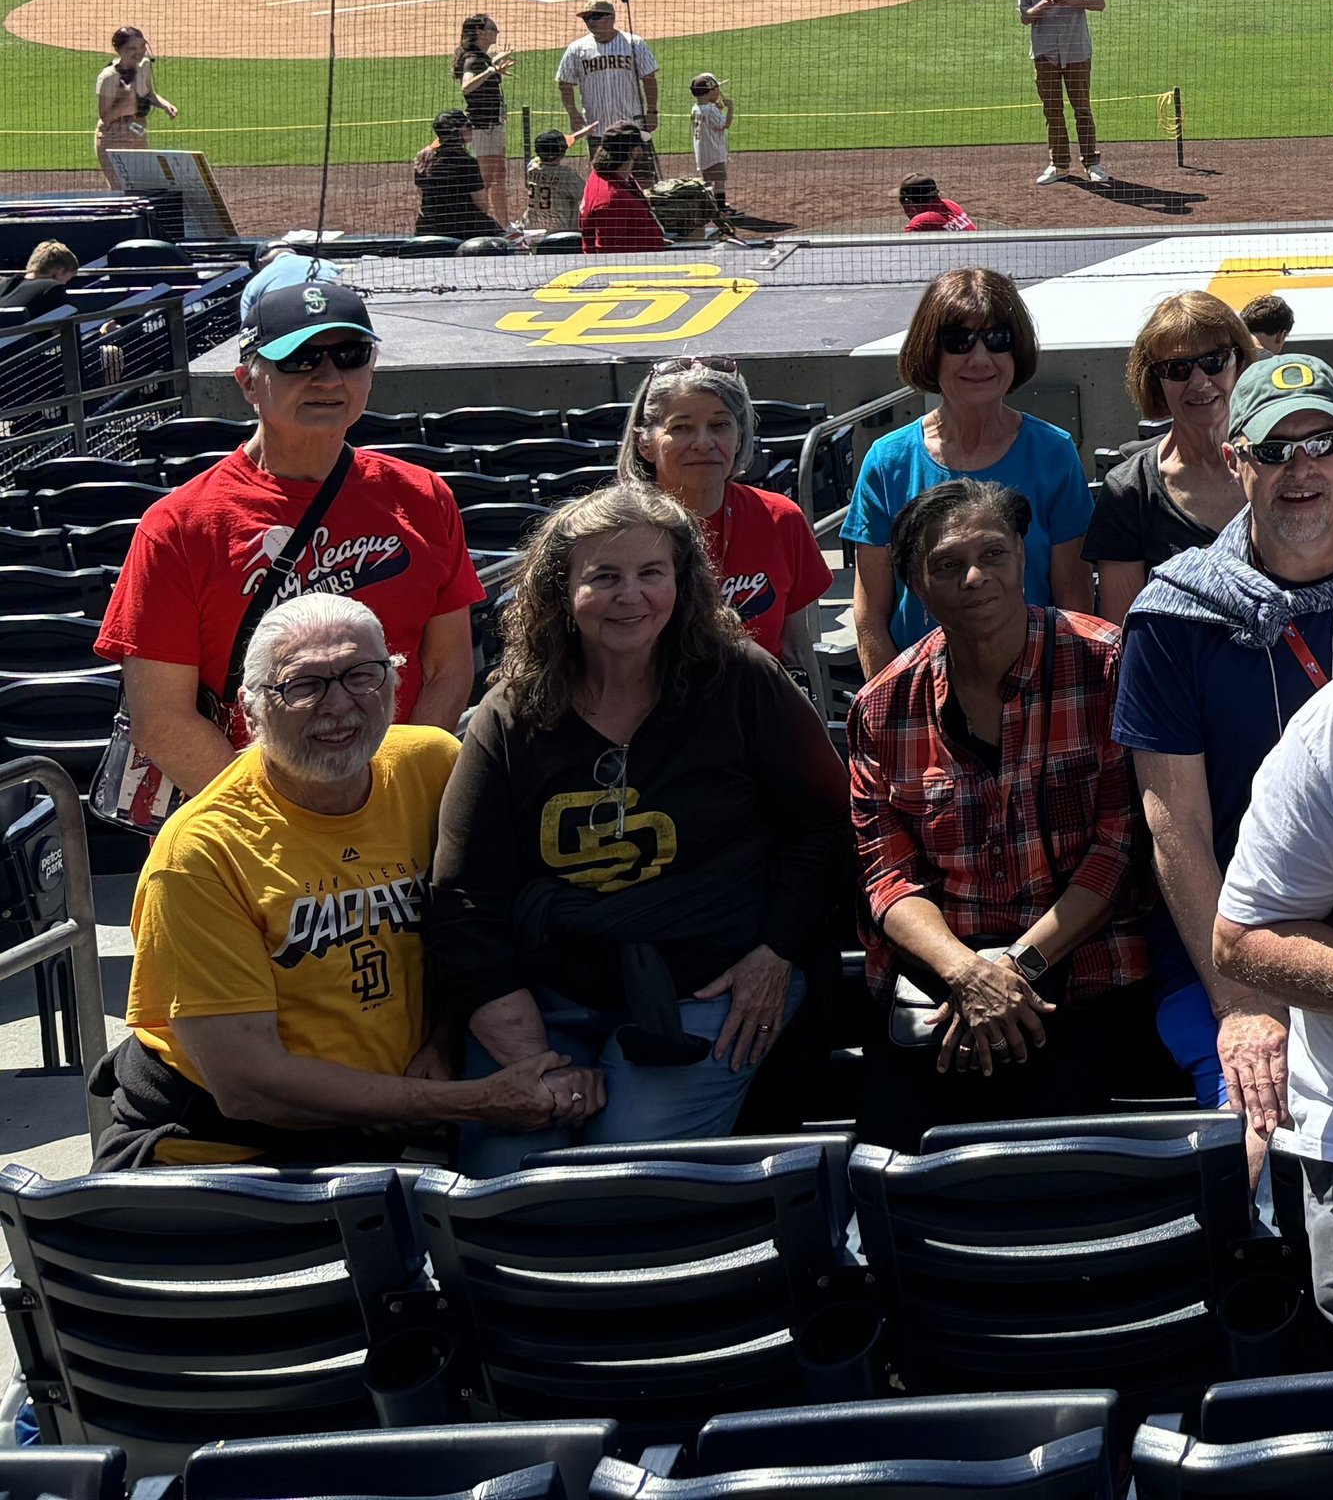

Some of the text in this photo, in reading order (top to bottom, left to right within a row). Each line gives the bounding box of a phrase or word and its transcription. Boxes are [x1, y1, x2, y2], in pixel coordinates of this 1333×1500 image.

[582, 55, 633, 76] PADRES
[308, 526, 402, 581] League
[45, 858, 64, 880] park
